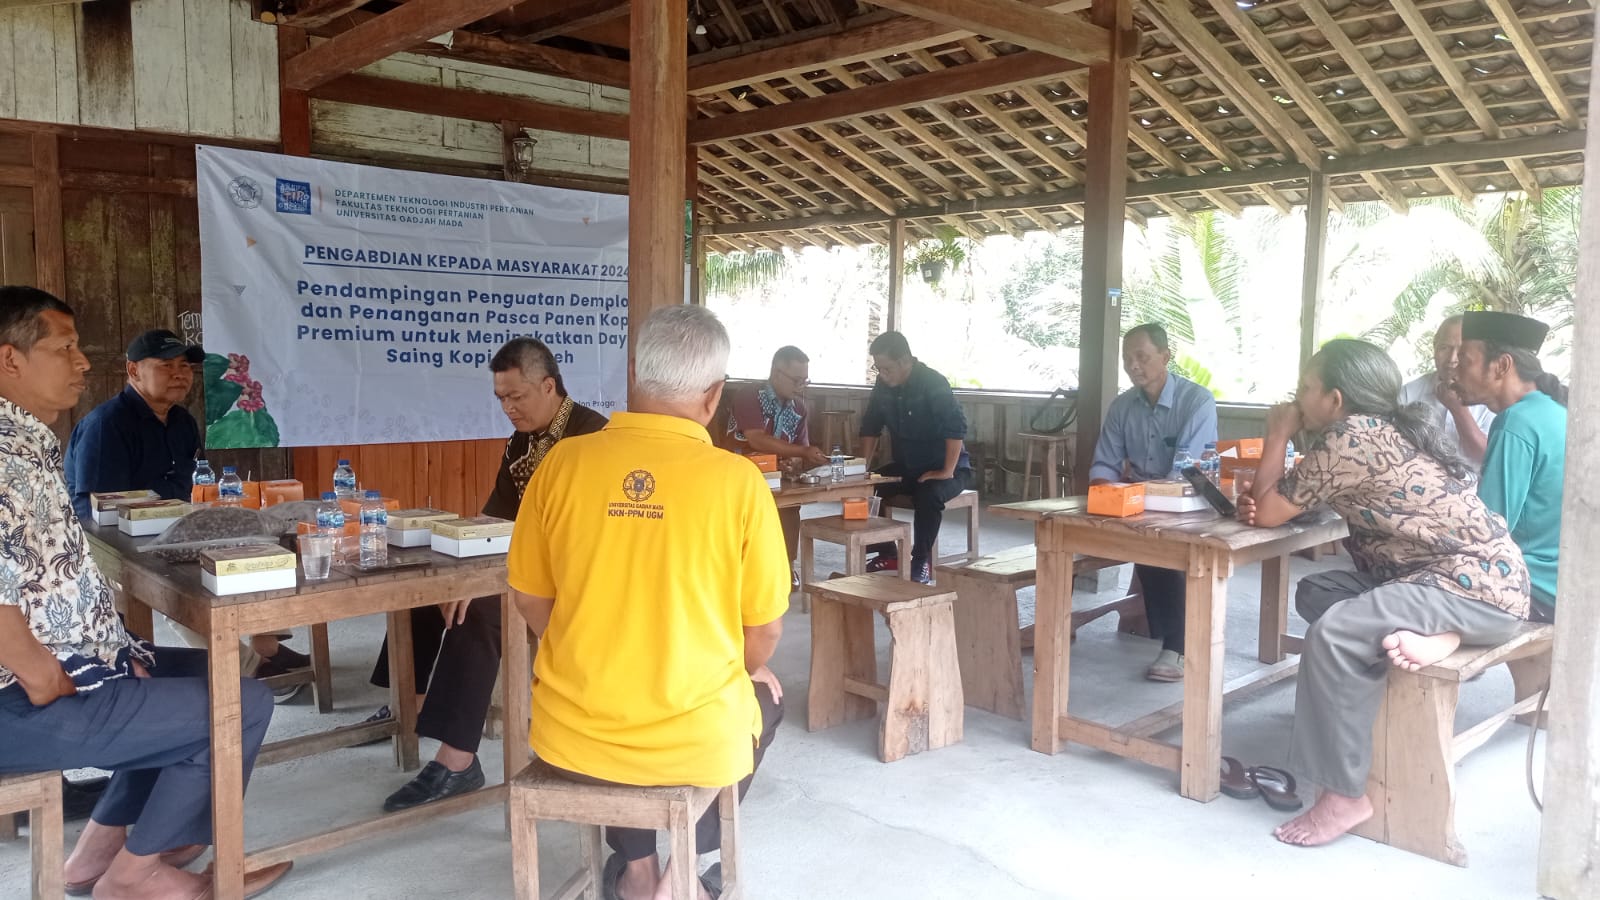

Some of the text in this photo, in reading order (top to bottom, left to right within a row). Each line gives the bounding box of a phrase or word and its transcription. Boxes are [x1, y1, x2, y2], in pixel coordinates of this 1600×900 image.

[335, 189, 534, 216] DEPARTEMEN TEKNOLOGI INDUSTRI PERTANIAN
[336, 199, 484, 220] FAKULTAS TEKNOLOGI PERTANIAN
[336, 208, 463, 227] UNIVERSITAS GADJAH MADA
[304, 245, 422, 266] PENGABDIAN
[427, 254, 492, 270] KEPADA
[497, 259, 598, 276] MASYARAKAT
[297, 280, 629, 311] Pendampingan Penguatan Demplo
[177, 310, 202, 331] Tem
[301, 303, 629, 330] dan Penanganan Pasca Panen Kop
[297, 325, 395, 342] Premium
[401, 329, 460, 343] untuk
[598, 332, 627, 349] Day
[387, 348, 492, 368] Saing Kopi
[608, 509, 664, 520] KKN-PPM UGM
